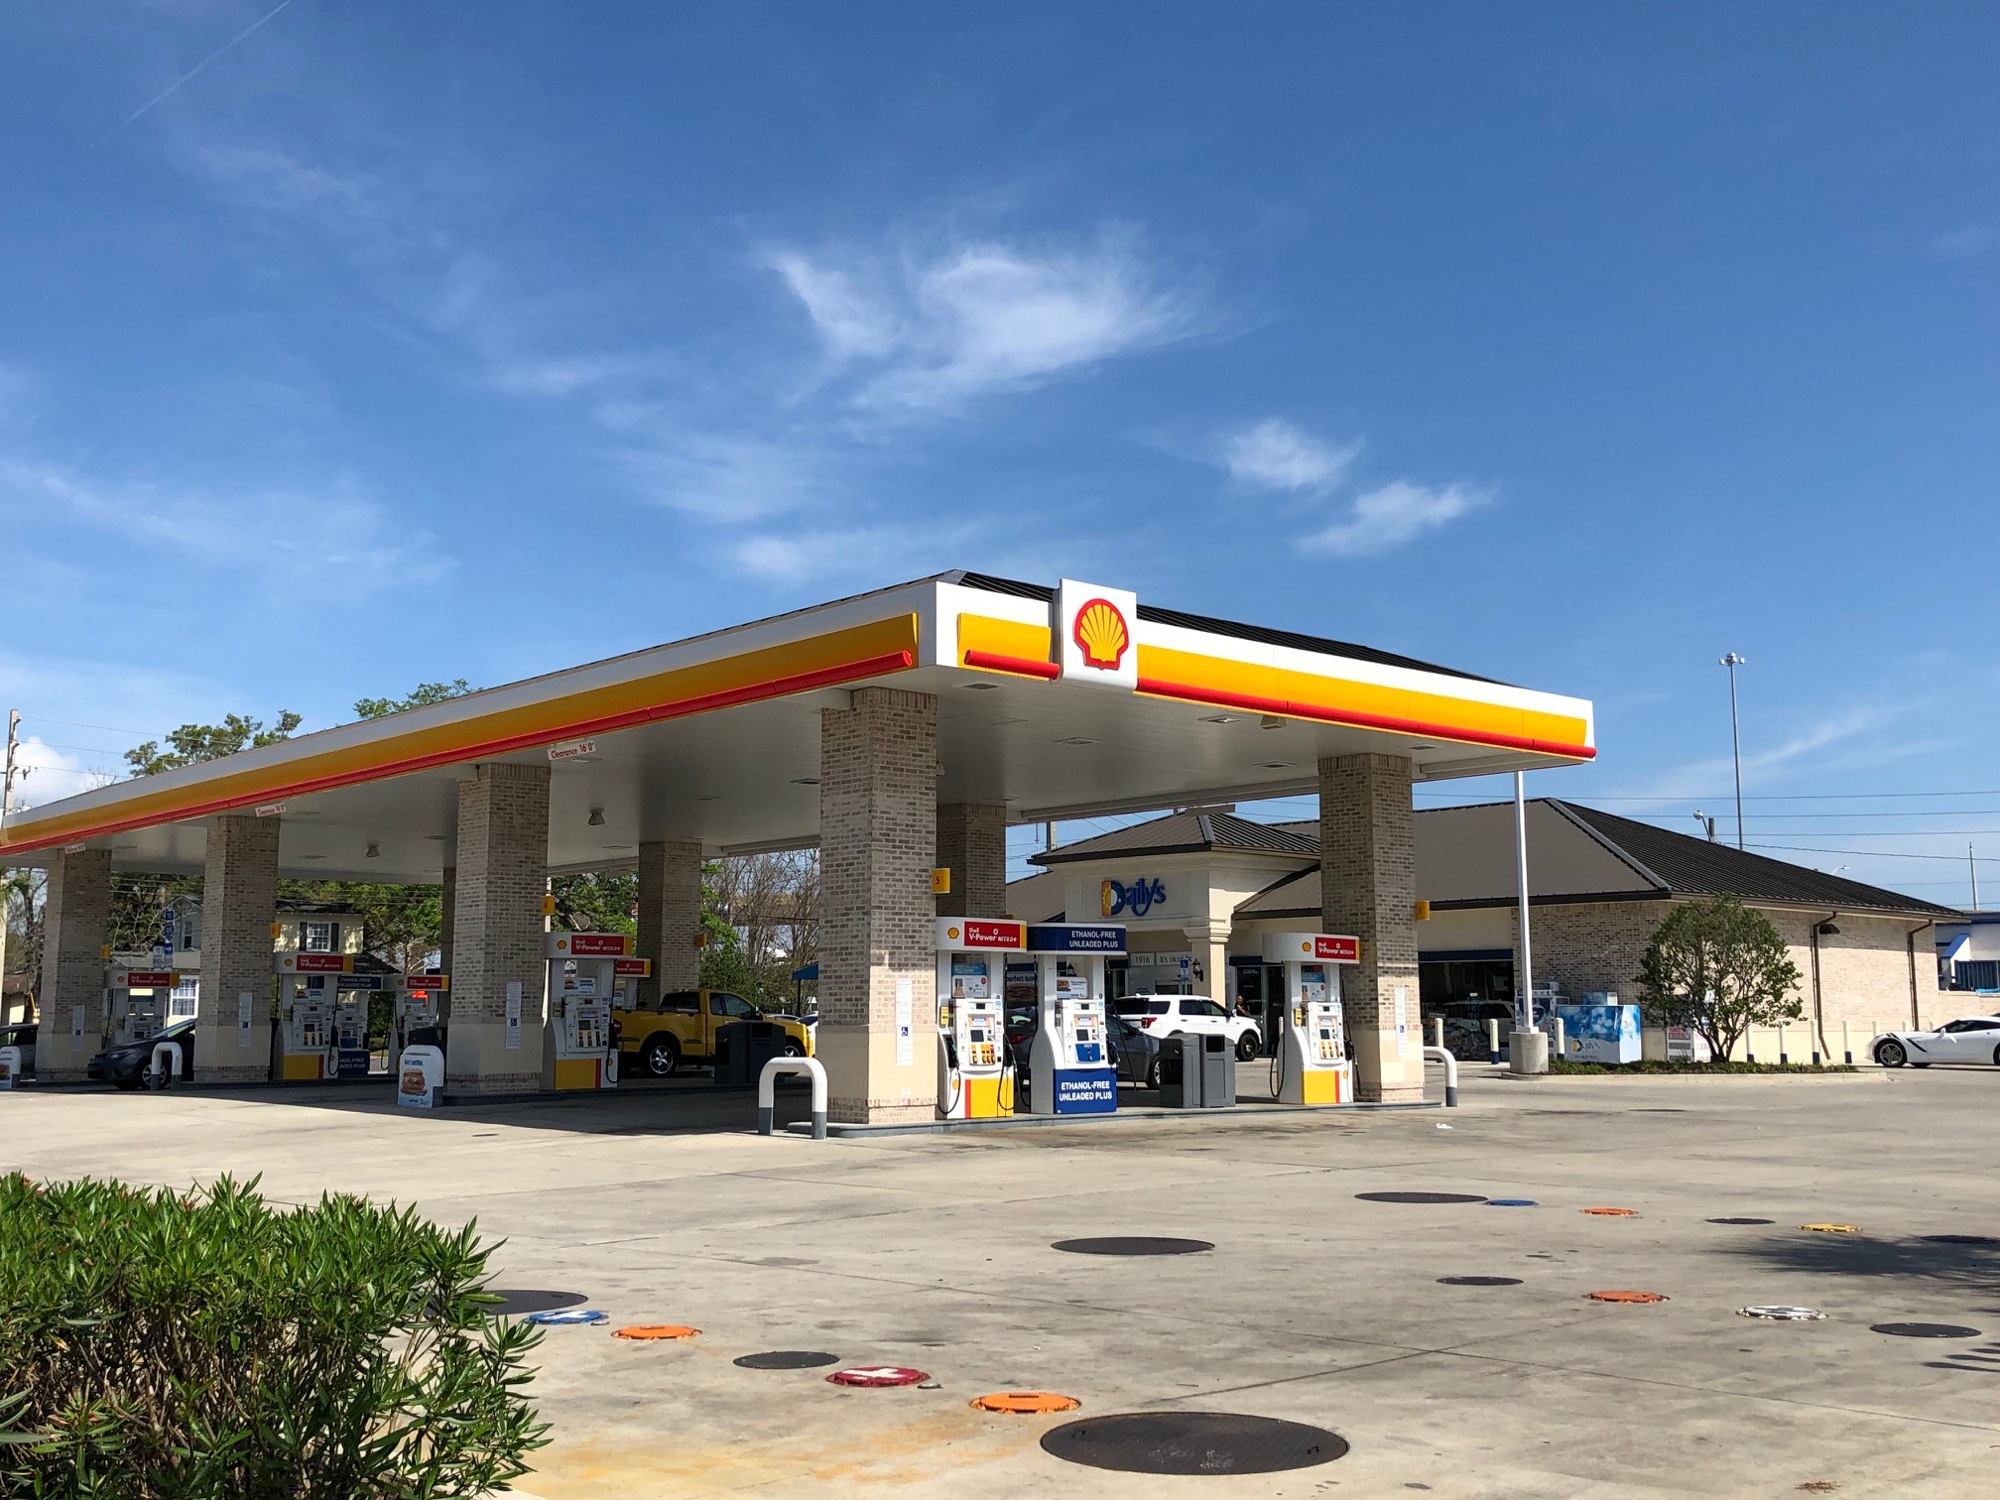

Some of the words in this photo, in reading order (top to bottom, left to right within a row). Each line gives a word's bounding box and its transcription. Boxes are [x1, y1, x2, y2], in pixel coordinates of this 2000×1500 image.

[551, 749, 578, 758] Clearance
[935, 876, 940, 885] 5
[1101, 878, 1166, 917] Daily's
[969, 932, 996, 941] V-Power
[1071, 930, 1116, 938] ETHANOL-FREE
[1069, 940, 1102, 948] UNLEADED
[1103, 940, 1118, 948] PLUS
[1319, 946, 1339, 954] V-Power
[1135, 956, 1150, 964] 1916
[1061, 1081, 1110, 1090] ETHANOL-FREE
[1059, 1092, 1094, 1101] UNLEADED
[1095, 1091, 1112, 1100] PLUS
